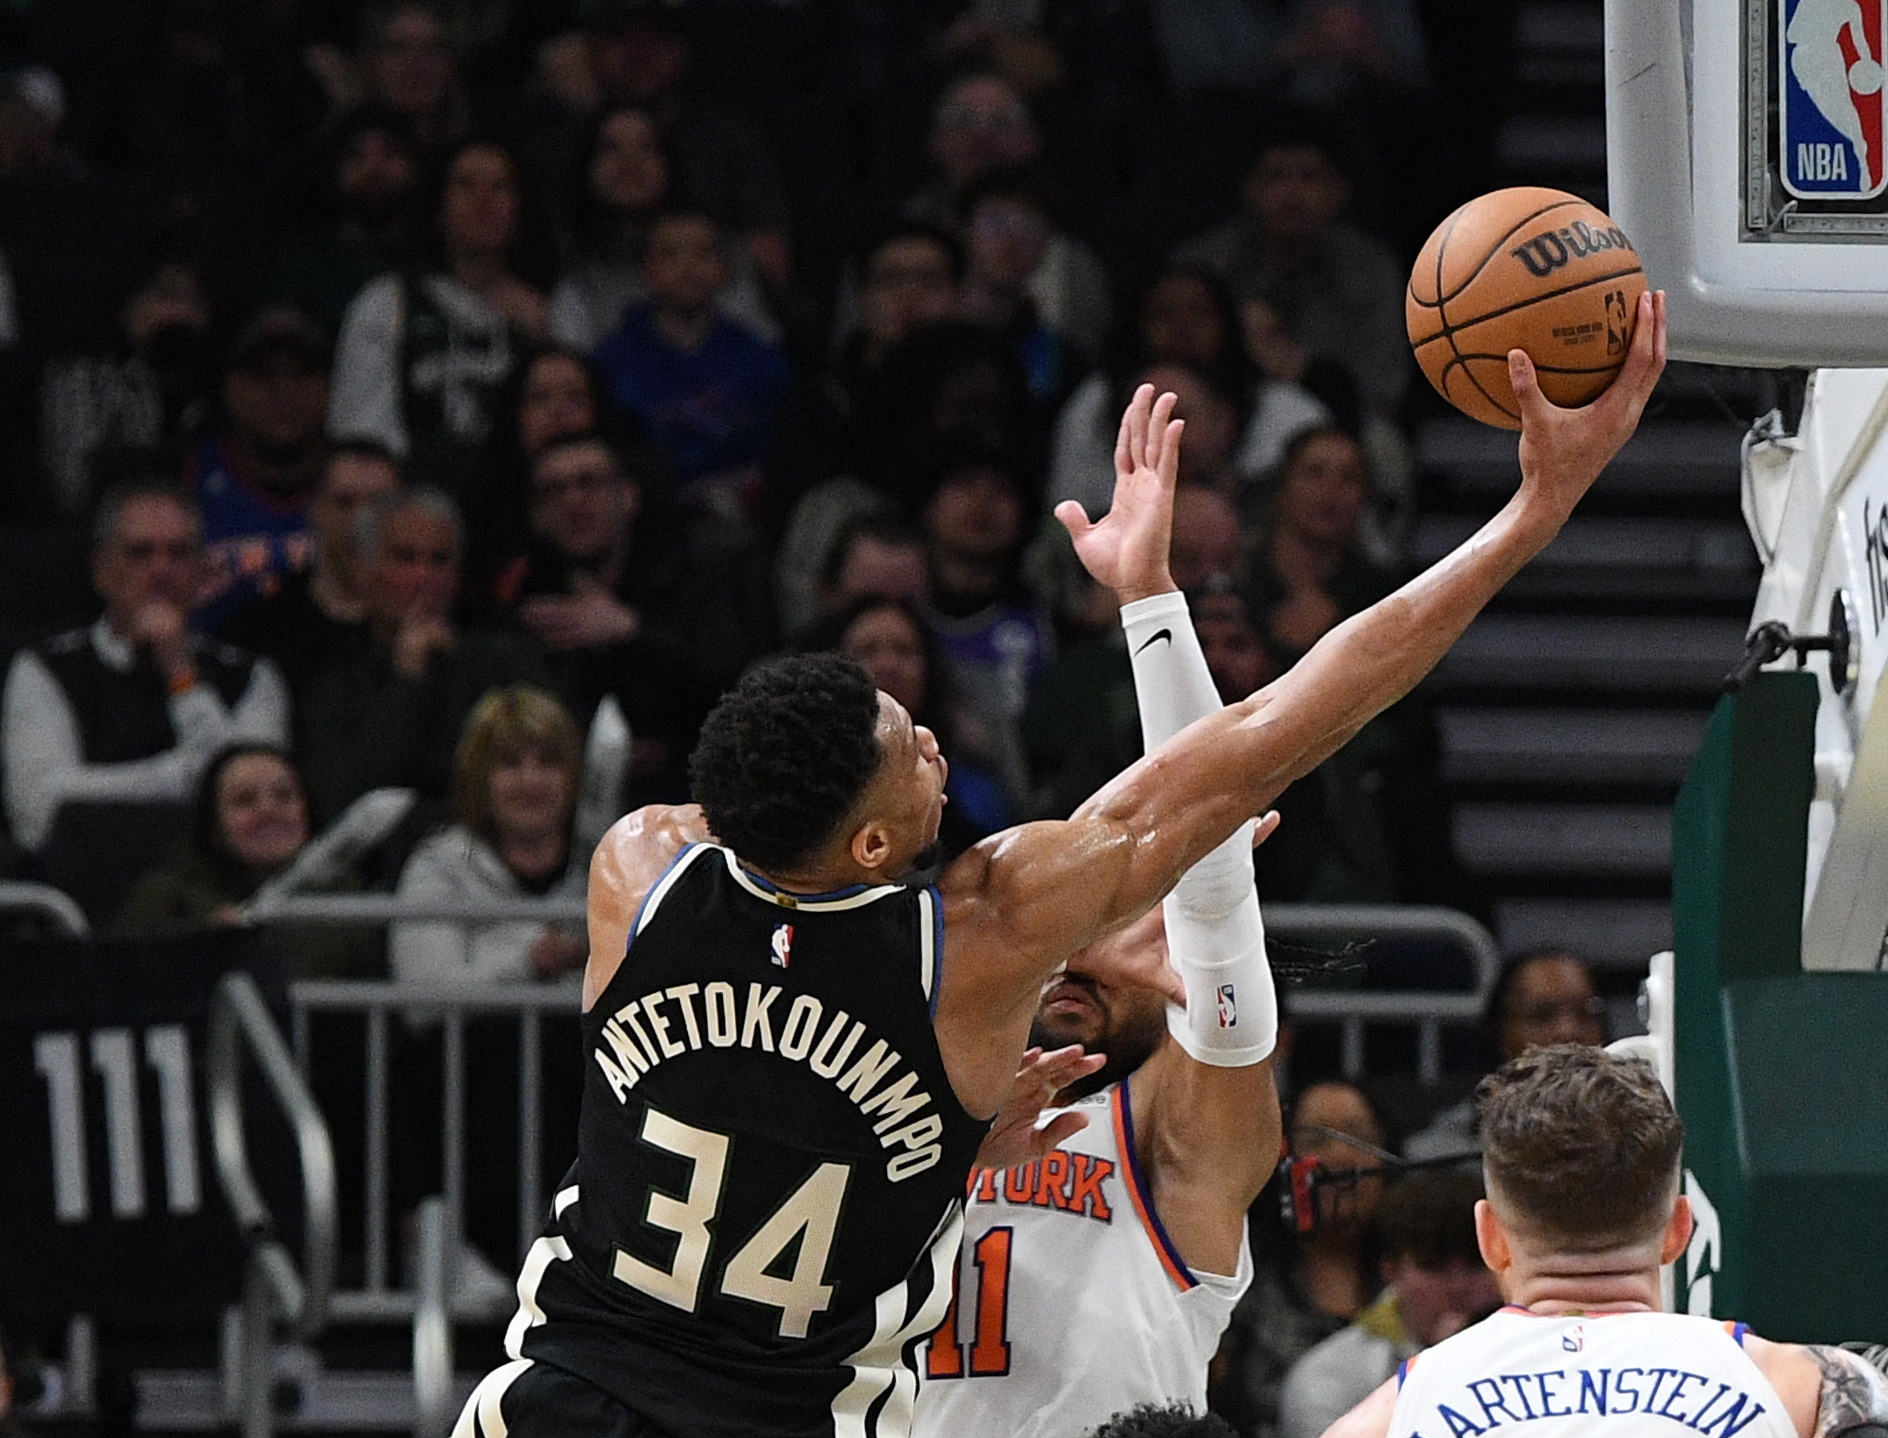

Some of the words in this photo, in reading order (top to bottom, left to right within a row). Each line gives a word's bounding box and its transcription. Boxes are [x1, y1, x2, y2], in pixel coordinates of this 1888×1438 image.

[1797, 142, 1849, 181] NBA
[32, 1024, 200, 1222] 111
[594, 981, 943, 1184] ANTETOKOUNMPO
[611, 1107, 852, 1340] 34
